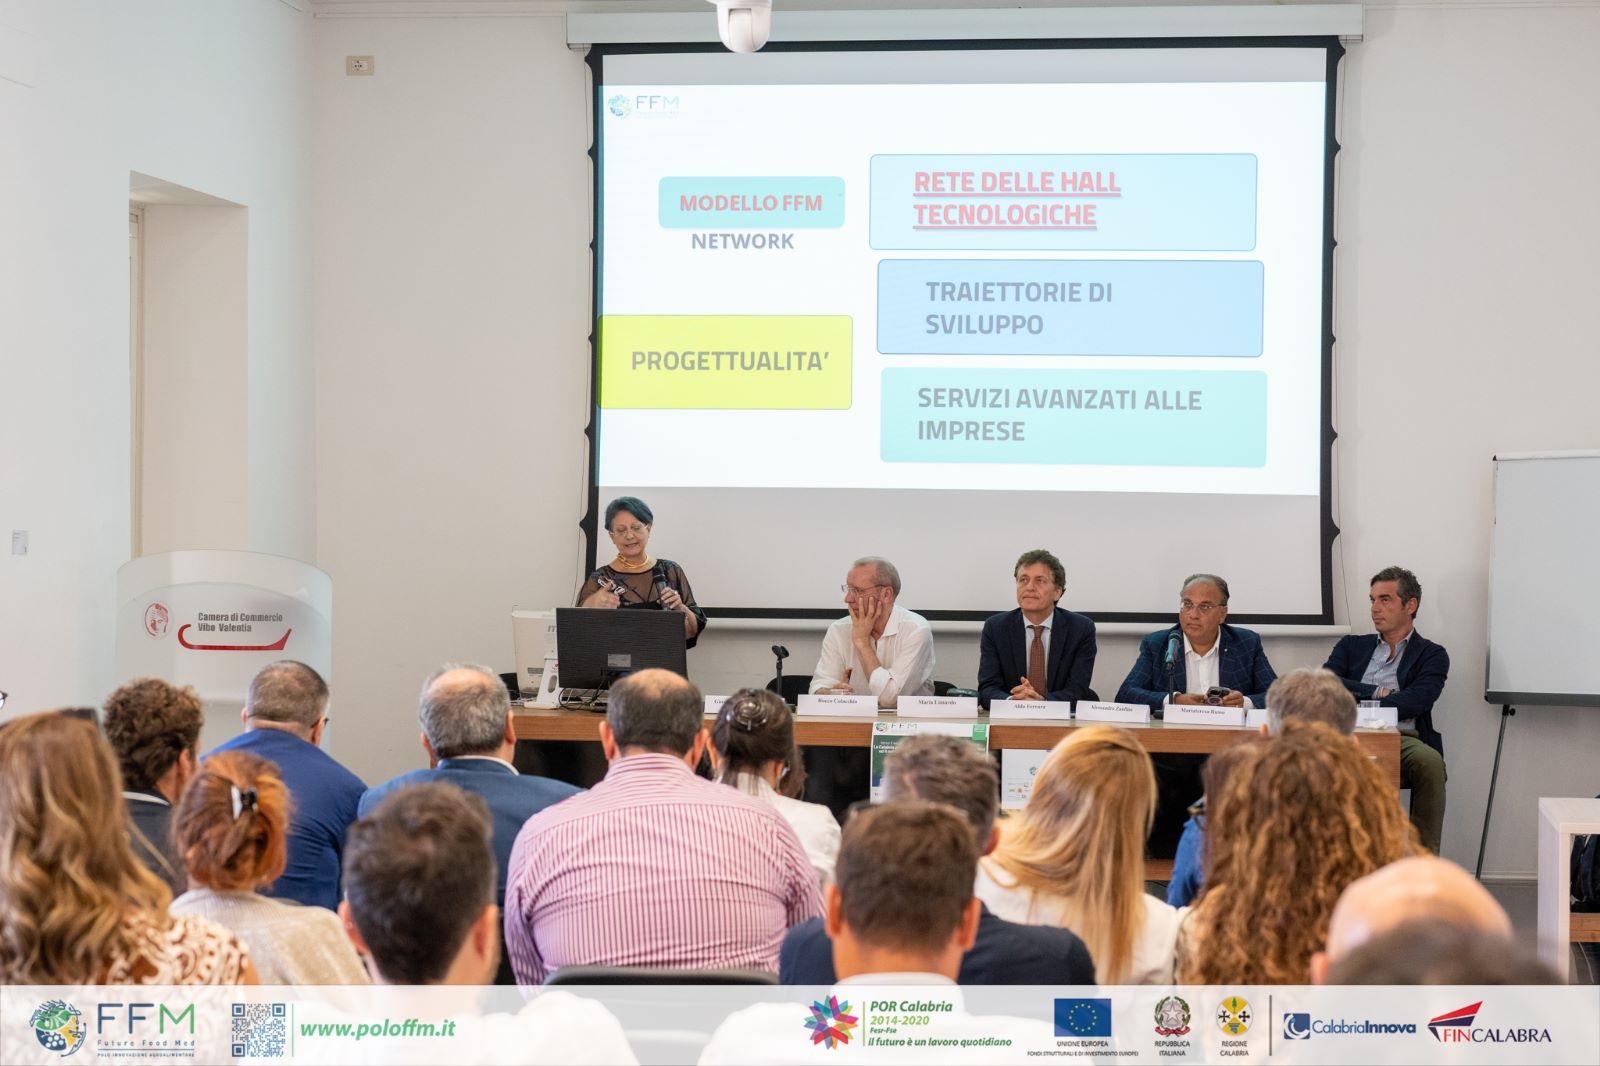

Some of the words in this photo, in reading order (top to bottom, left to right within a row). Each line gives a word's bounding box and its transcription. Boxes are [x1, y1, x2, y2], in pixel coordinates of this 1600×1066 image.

[636, 95, 679, 110] FFM
[914, 171, 975, 196] RETE
[981, 171, 1054, 196] DELLE
[1060, 171, 1122, 196] HALL
[679, 194, 778, 212] MODELLO
[782, 194, 823, 212] FFM
[913, 203, 1098, 229] TECNOLOGICHE
[691, 232, 795, 250] NETWORK
[926, 281, 1083, 303] TRAIETTORIE
[1089, 282, 1113, 303] DI
[925, 313, 1044, 336] SVILUPPO
[917, 387, 1012, 409] SERVIZI
[1016, 388, 1137, 410] AVANZATI
[1143, 390, 1203, 411] ALLE
[917, 420, 1026, 442] IMPRESE
[198, 612, 230, 622] Camera
[230, 613, 239, 622] di
[240, 613, 283, 622] Commercio
[198, 622, 216, 632] Vibo
[218, 623, 252, 632] Valentia
